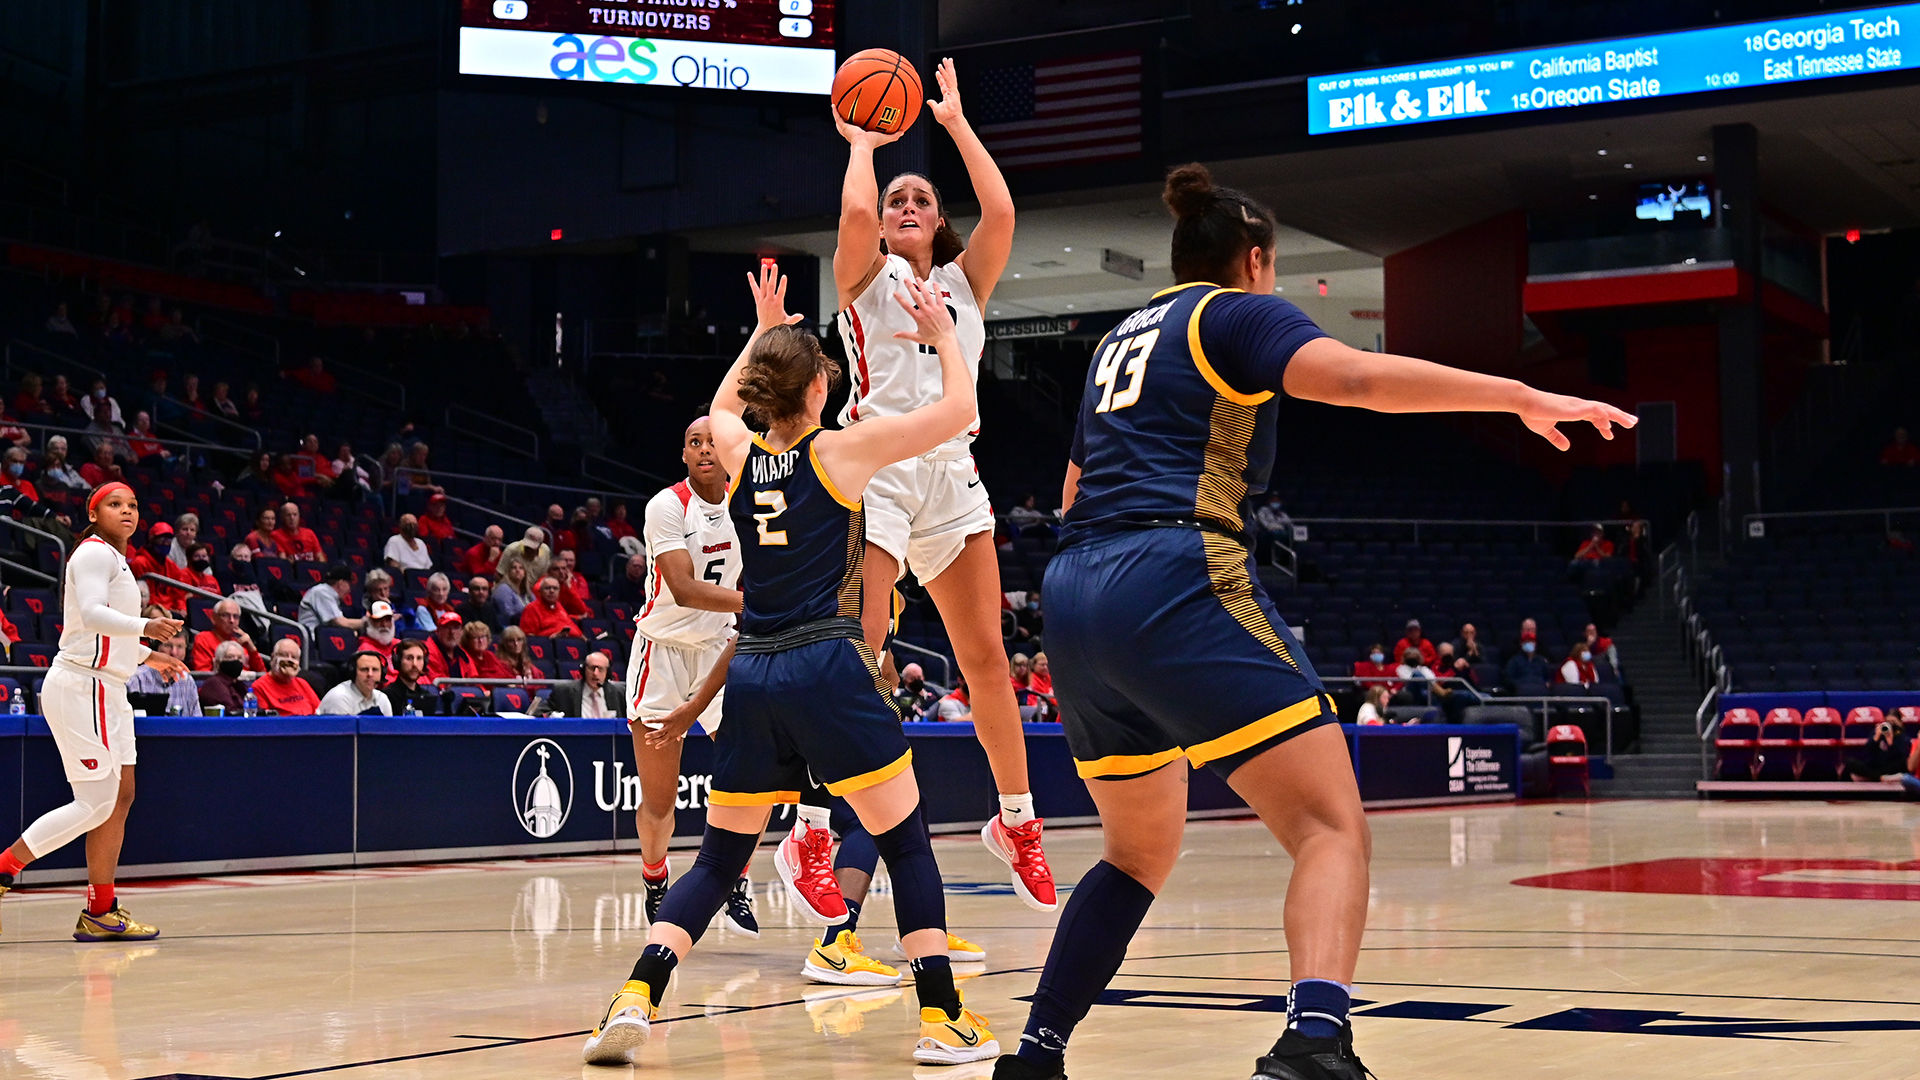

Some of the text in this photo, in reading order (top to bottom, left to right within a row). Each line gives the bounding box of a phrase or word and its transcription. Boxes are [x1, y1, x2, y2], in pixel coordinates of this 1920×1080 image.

[588, 8, 711, 31] TURNOVERS
[1849, 15, 1901, 41] Tech
[550, 33, 750, 90] aes Ohio
[1318, 81, 1337, 92] OUT
[1338, 79, 1352, 90] OF
[1352, 75, 1380, 88] TOWN
[1380, 71, 1417, 85] SCORES
[1418, 65, 1463, 80] BROUGHT
[1464, 64, 1477, 74] TO
[1478, 62, 1499, 73] YOU
[1529, 46, 1659, 79] California Baptist
[1764, 45, 1902, 80] East Tennessee State
[1328, 79, 1488, 128] Elk & Elk
[1608, 76, 1661, 100] State
[985, 320, 1069, 338] NCESSIONS
[1095, 328, 1160, 414] 43
[753, 489, 788, 546] 2
[703, 558, 725, 586] 5
